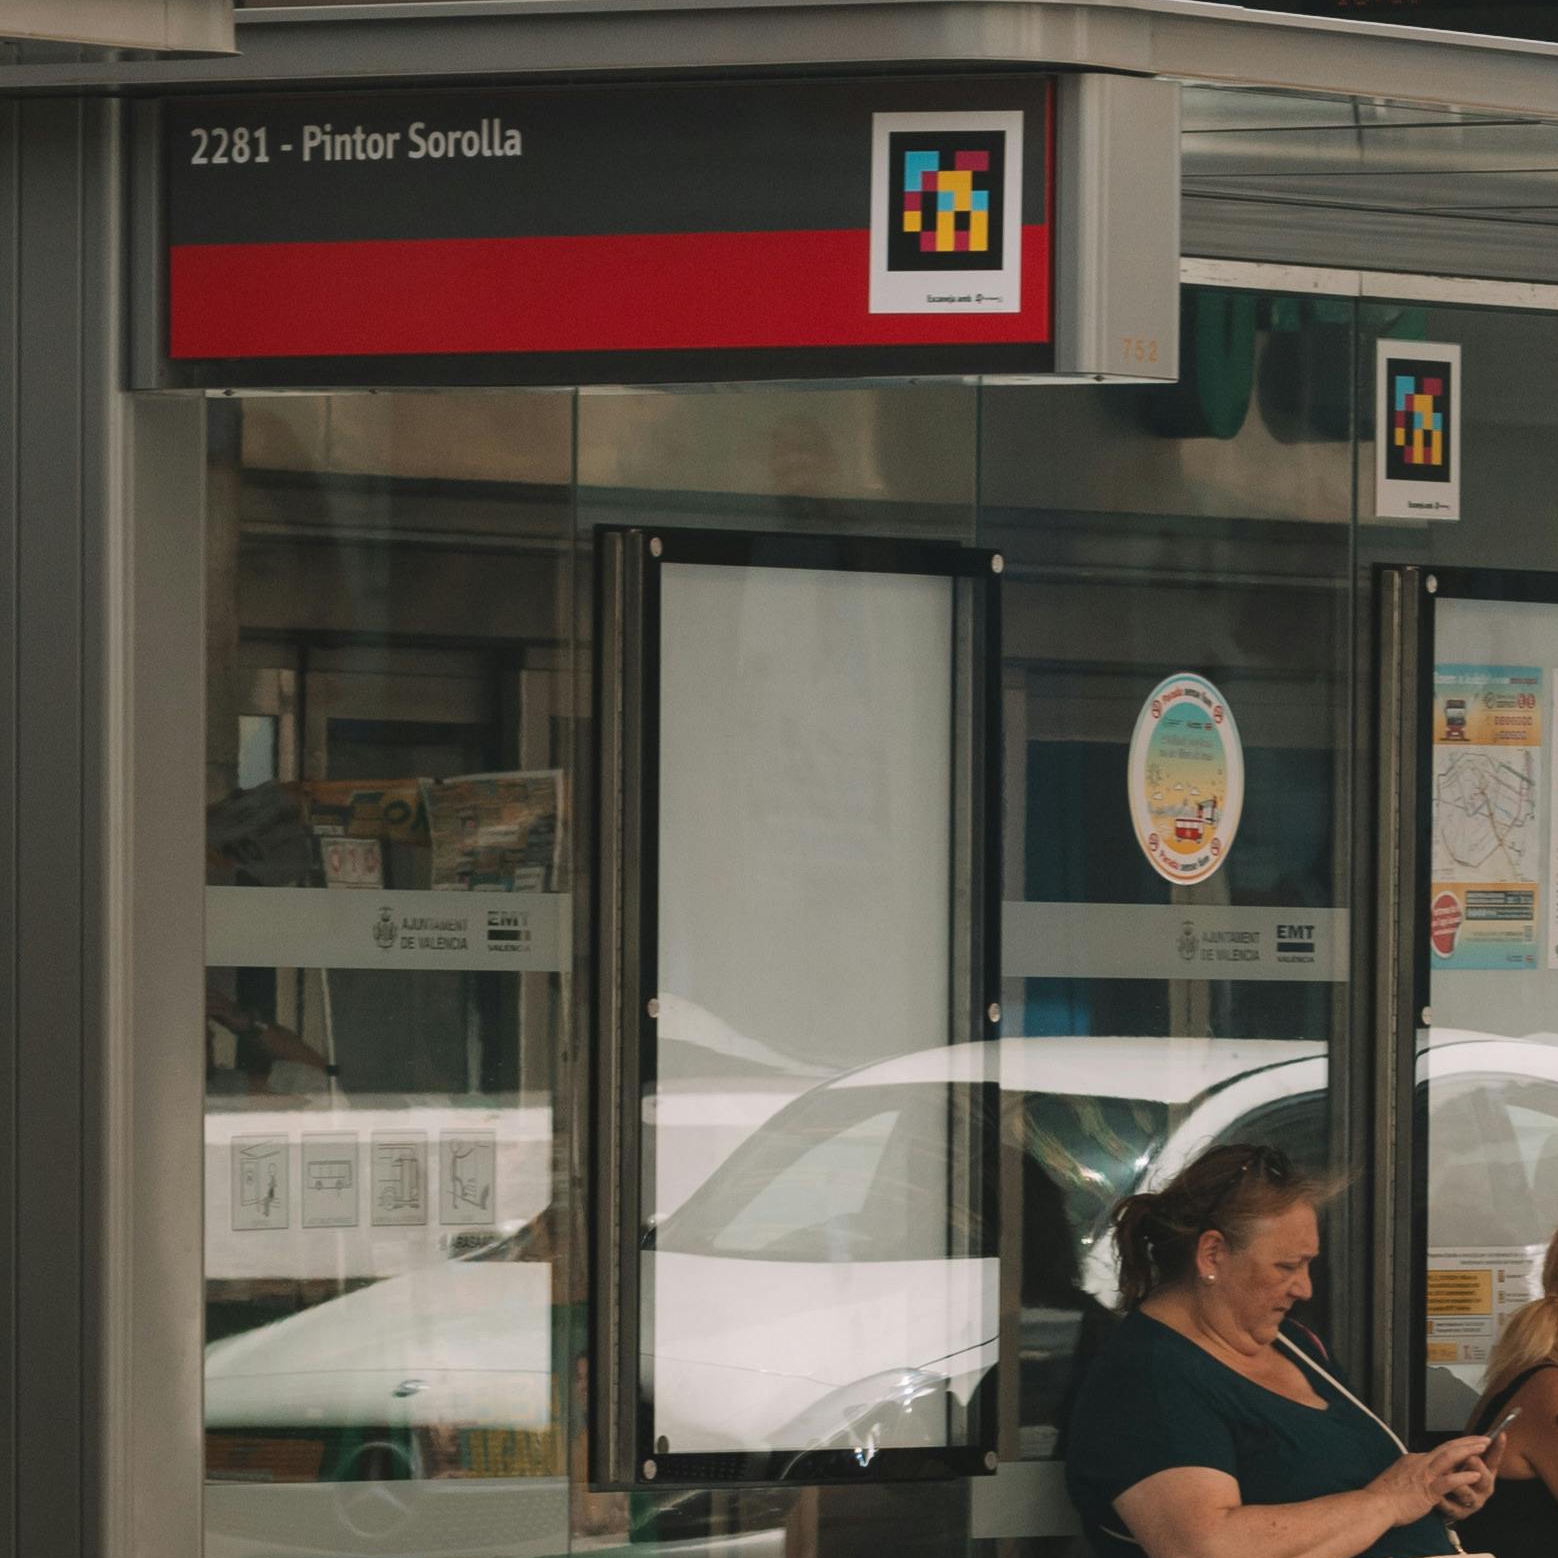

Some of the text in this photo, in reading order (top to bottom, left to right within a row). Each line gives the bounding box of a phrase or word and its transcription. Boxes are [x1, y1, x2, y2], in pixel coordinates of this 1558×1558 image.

[191, 127, 270, 165] 2281
[302, 124, 400, 162] Pintor
[408, 118, 523, 159] Sorolla
[1121, 337, 1160, 364] 752
[1276, 924, 1315, 940] EMT
[400, 937, 416, 950] DE
